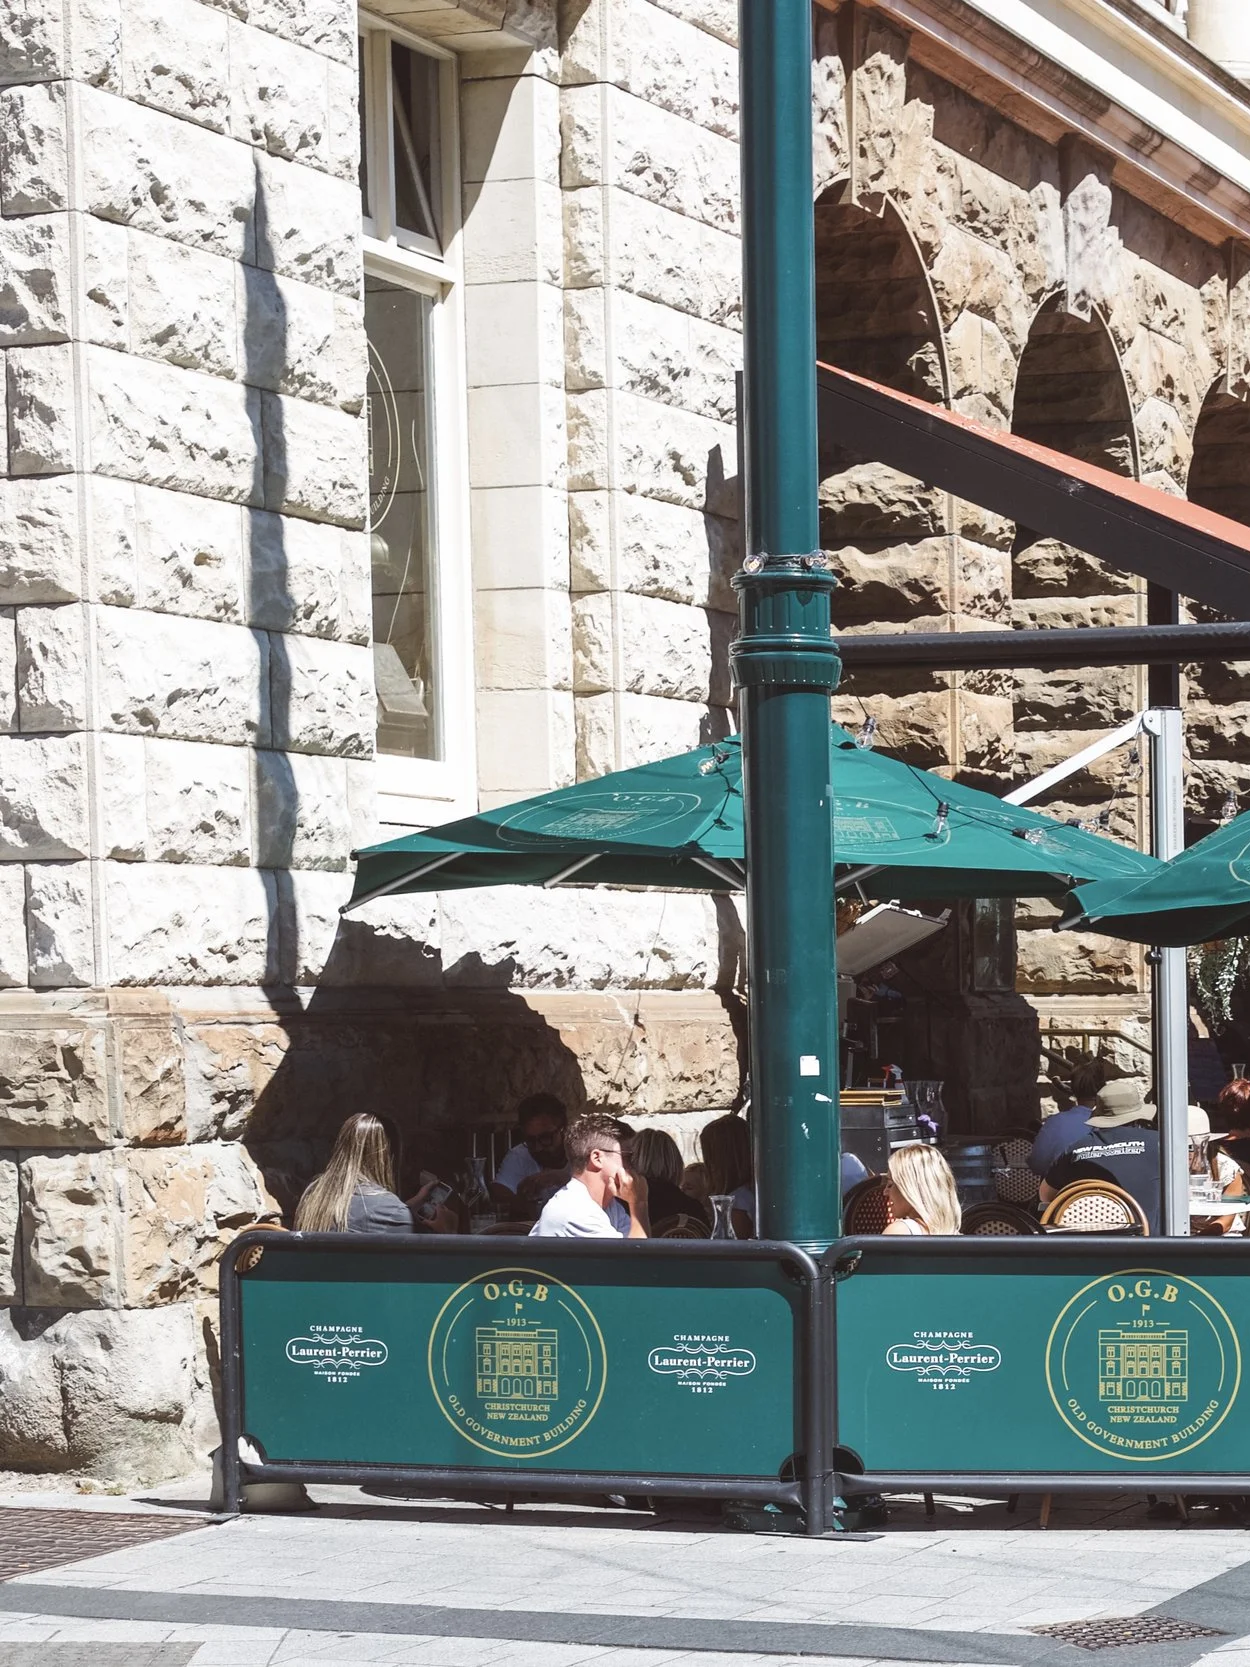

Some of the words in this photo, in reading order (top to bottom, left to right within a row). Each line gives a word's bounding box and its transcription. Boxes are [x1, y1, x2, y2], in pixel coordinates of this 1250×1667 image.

[370, 476, 390, 515] UILDING
[483, 1279, 549, 1302] O.G.B
[1107, 1280, 1179, 1303] O.G.B
[506, 1318, 527, 1327] 1913
[1132, 1319, 1154, 1328] 1913
[309, 1325, 363, 1333] CHAMPAGNE
[673, 1334, 730, 1342] CHAMPAGNE
[913, 1331, 974, 1339] CHAMPAGNE
[291, 1345, 383, 1358] Laurent-Perrier
[654, 1355, 750, 1368] Laurent-Perrier
[892, 1352, 995, 1364] Laurent-Perrier
[484, 1402, 551, 1412] CHRISTCHURCH
[1107, 1405, 1180, 1414] CHRISTCHURCH
[448, 1394, 466, 1418] OLD
[465, 1417, 541, 1447] GOVERNMENT
[542, 1398, 588, 1442] BUILDING
[487, 1412, 506, 1420] NEW
[508, 1412, 548, 1422] ZEALAND
[1109, 1415, 1131, 1423] NEW
[1133, 1415, 1177, 1424] ZEALAND
[1067, 1398, 1087, 1422] OLD
[1086, 1420, 1169, 1449] GOVERNMENT
[1171, 1399, 1220, 1444] BUILDING
